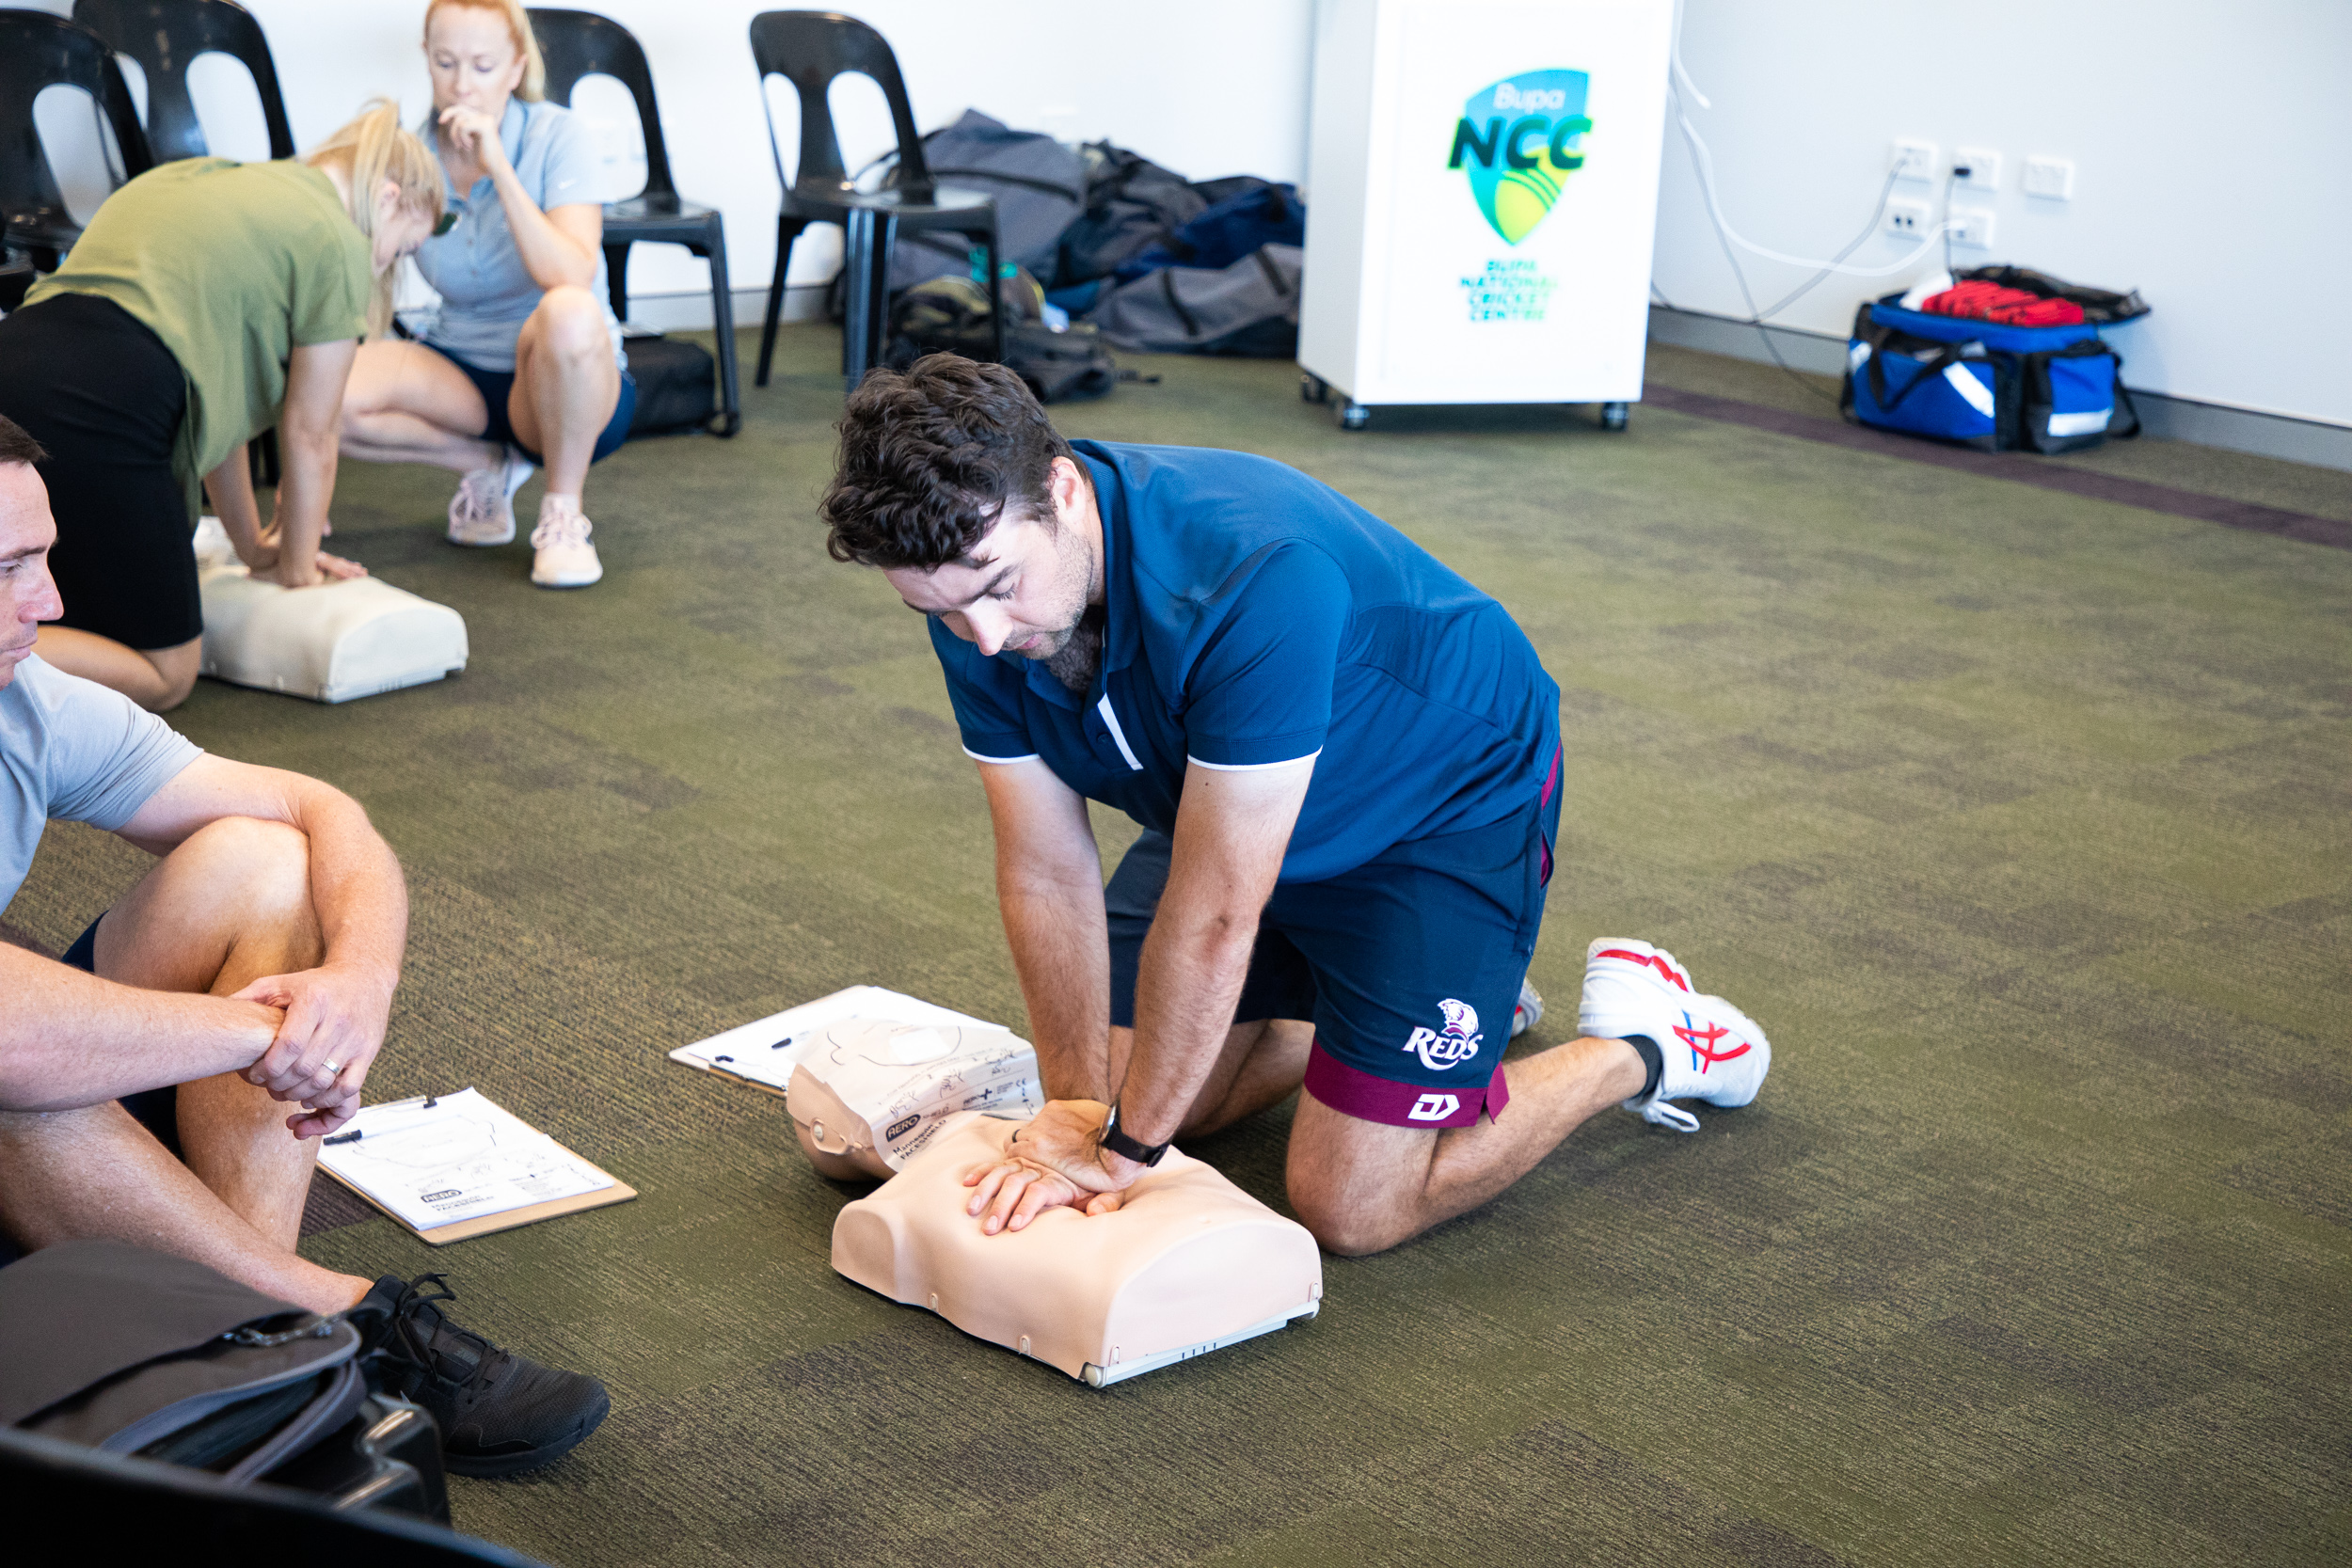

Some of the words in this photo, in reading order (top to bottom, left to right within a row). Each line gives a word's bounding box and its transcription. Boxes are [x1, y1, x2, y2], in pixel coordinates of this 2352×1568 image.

[1494, 83, 1565, 113] Bupa
[1449, 118, 1593, 169] NCC
[886, 1116, 919, 1140] AERO
[423, 1190, 460, 1203] AERO
